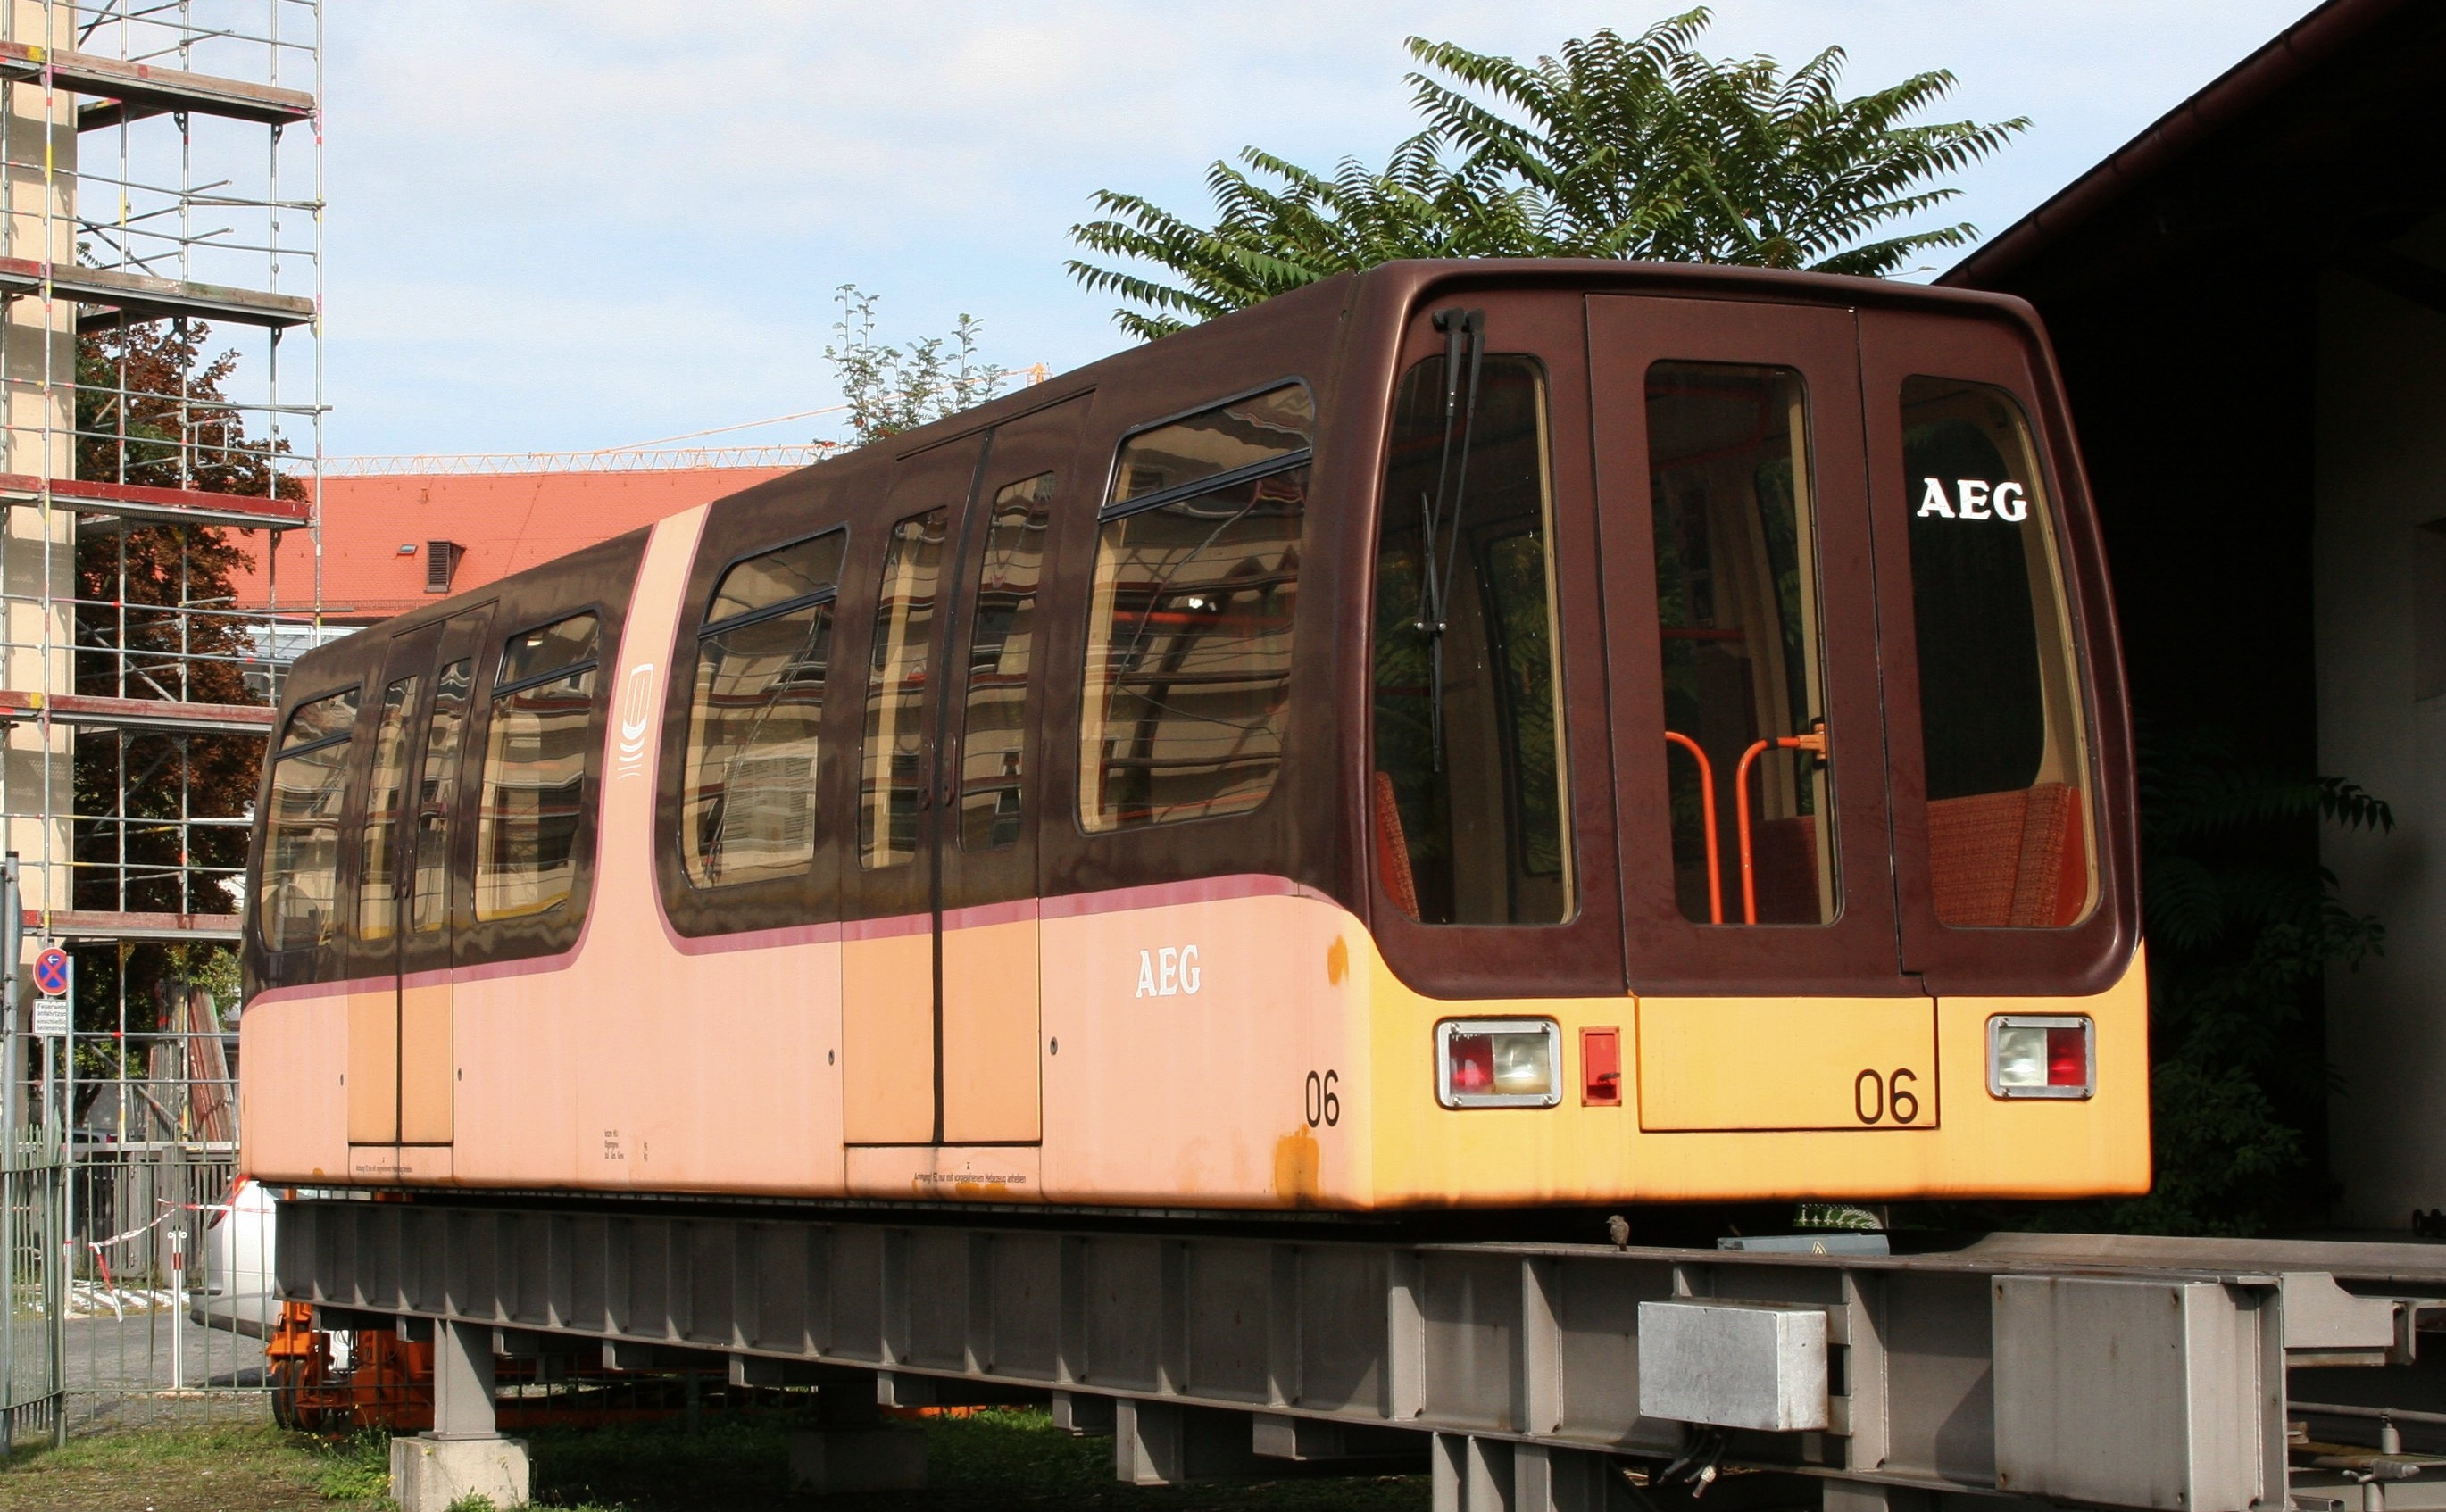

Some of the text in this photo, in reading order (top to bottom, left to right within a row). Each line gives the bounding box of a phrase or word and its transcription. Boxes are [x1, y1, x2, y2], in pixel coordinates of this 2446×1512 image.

[1917, 478, 2027, 522] AEG
[1135, 944, 1201, 999] AEG
[1305, 1069, 1340, 1128] 06
[1855, 1068, 1918, 1125] 06
